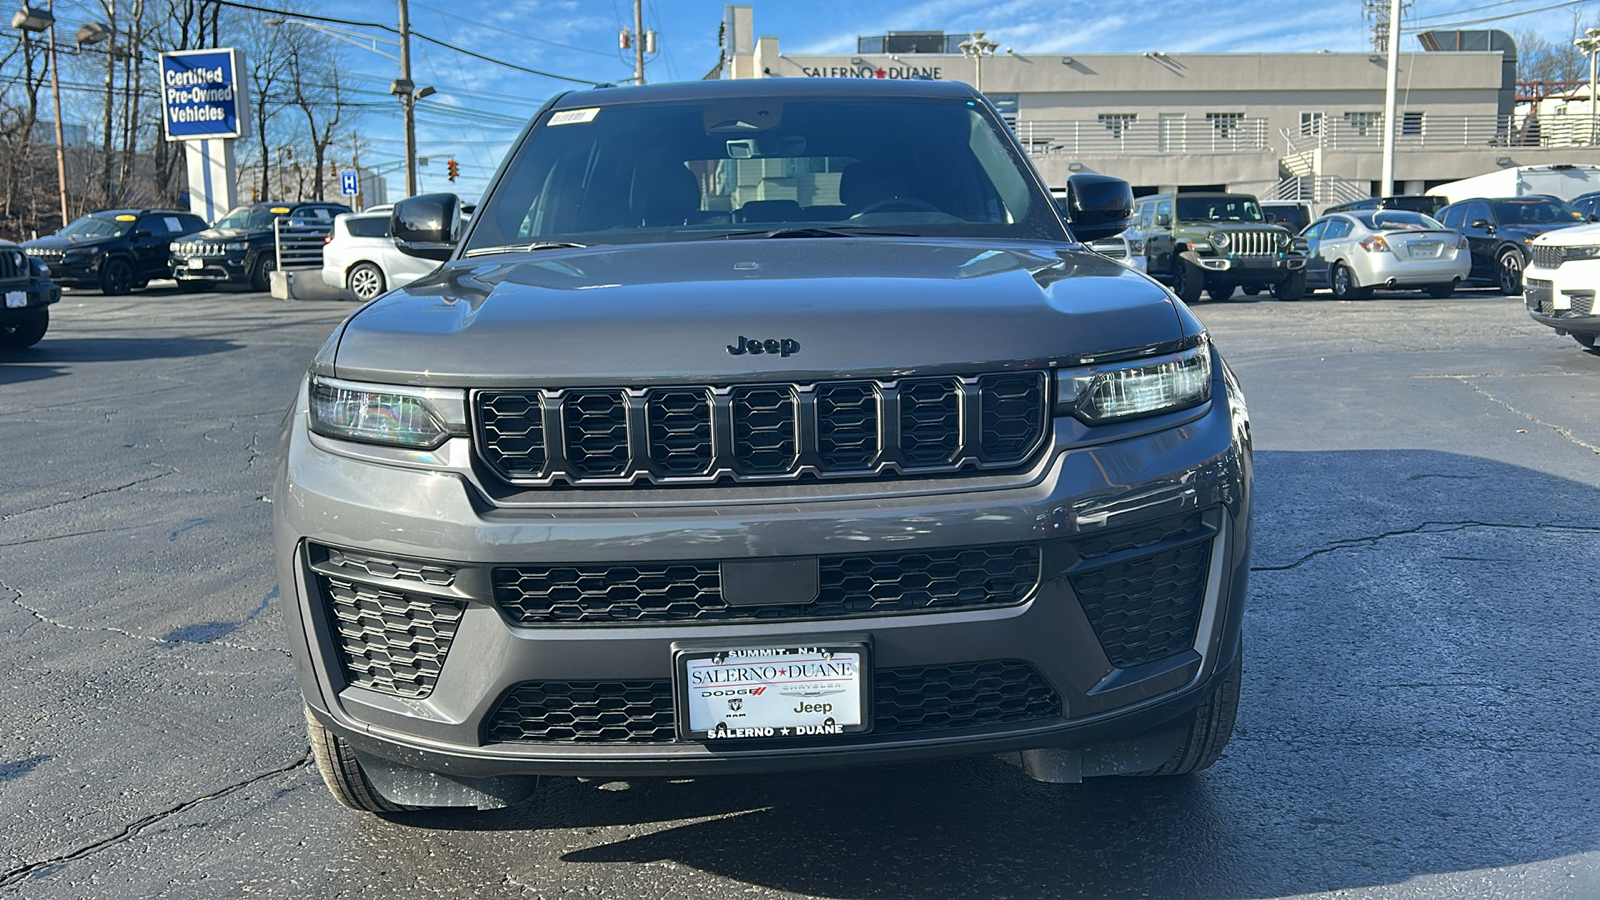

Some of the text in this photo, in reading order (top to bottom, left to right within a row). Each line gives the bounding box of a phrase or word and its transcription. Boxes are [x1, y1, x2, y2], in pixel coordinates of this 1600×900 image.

[166, 67, 223, 86] Certified
[803, 67, 942, 80] SALERNO DUANE
[168, 85, 232, 104] Pre-Owned
[170, 105, 225, 123] Vehicles
[344, 175, 355, 188] H
[726, 336, 801, 357] Jeep
[692, 663, 853, 685] SALERNO DUANE
[702, 689, 759, 697] DODGE
[793, 701, 833, 714] Jeep
[707, 725, 843, 739] SALERNO DUANE
